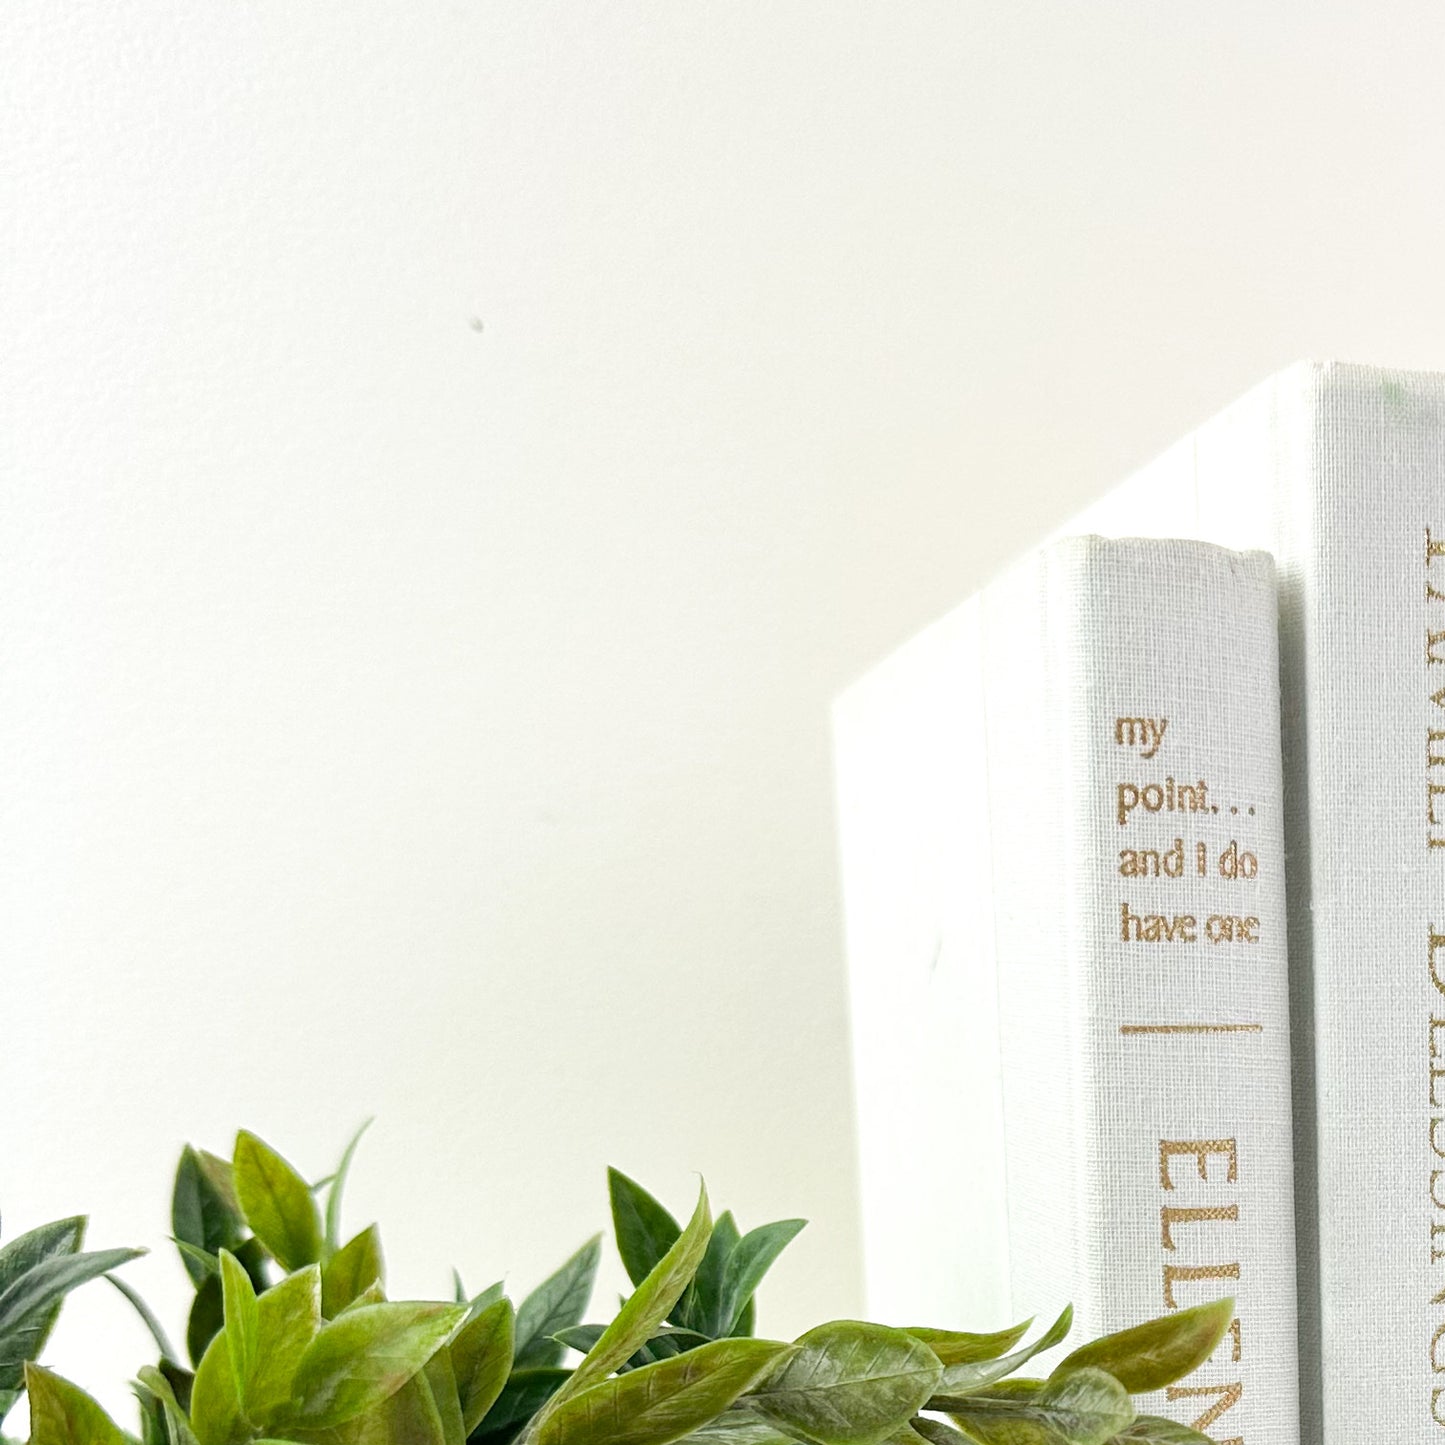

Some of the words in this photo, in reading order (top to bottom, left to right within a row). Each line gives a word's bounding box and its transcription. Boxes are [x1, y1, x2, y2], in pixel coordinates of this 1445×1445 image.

[1114, 716, 1170, 759] my
[1118, 837, 1184, 879] and
[1218, 840, 1259, 881] do
[1120, 902, 1198, 944] have
[1204, 913, 1262, 944] one
